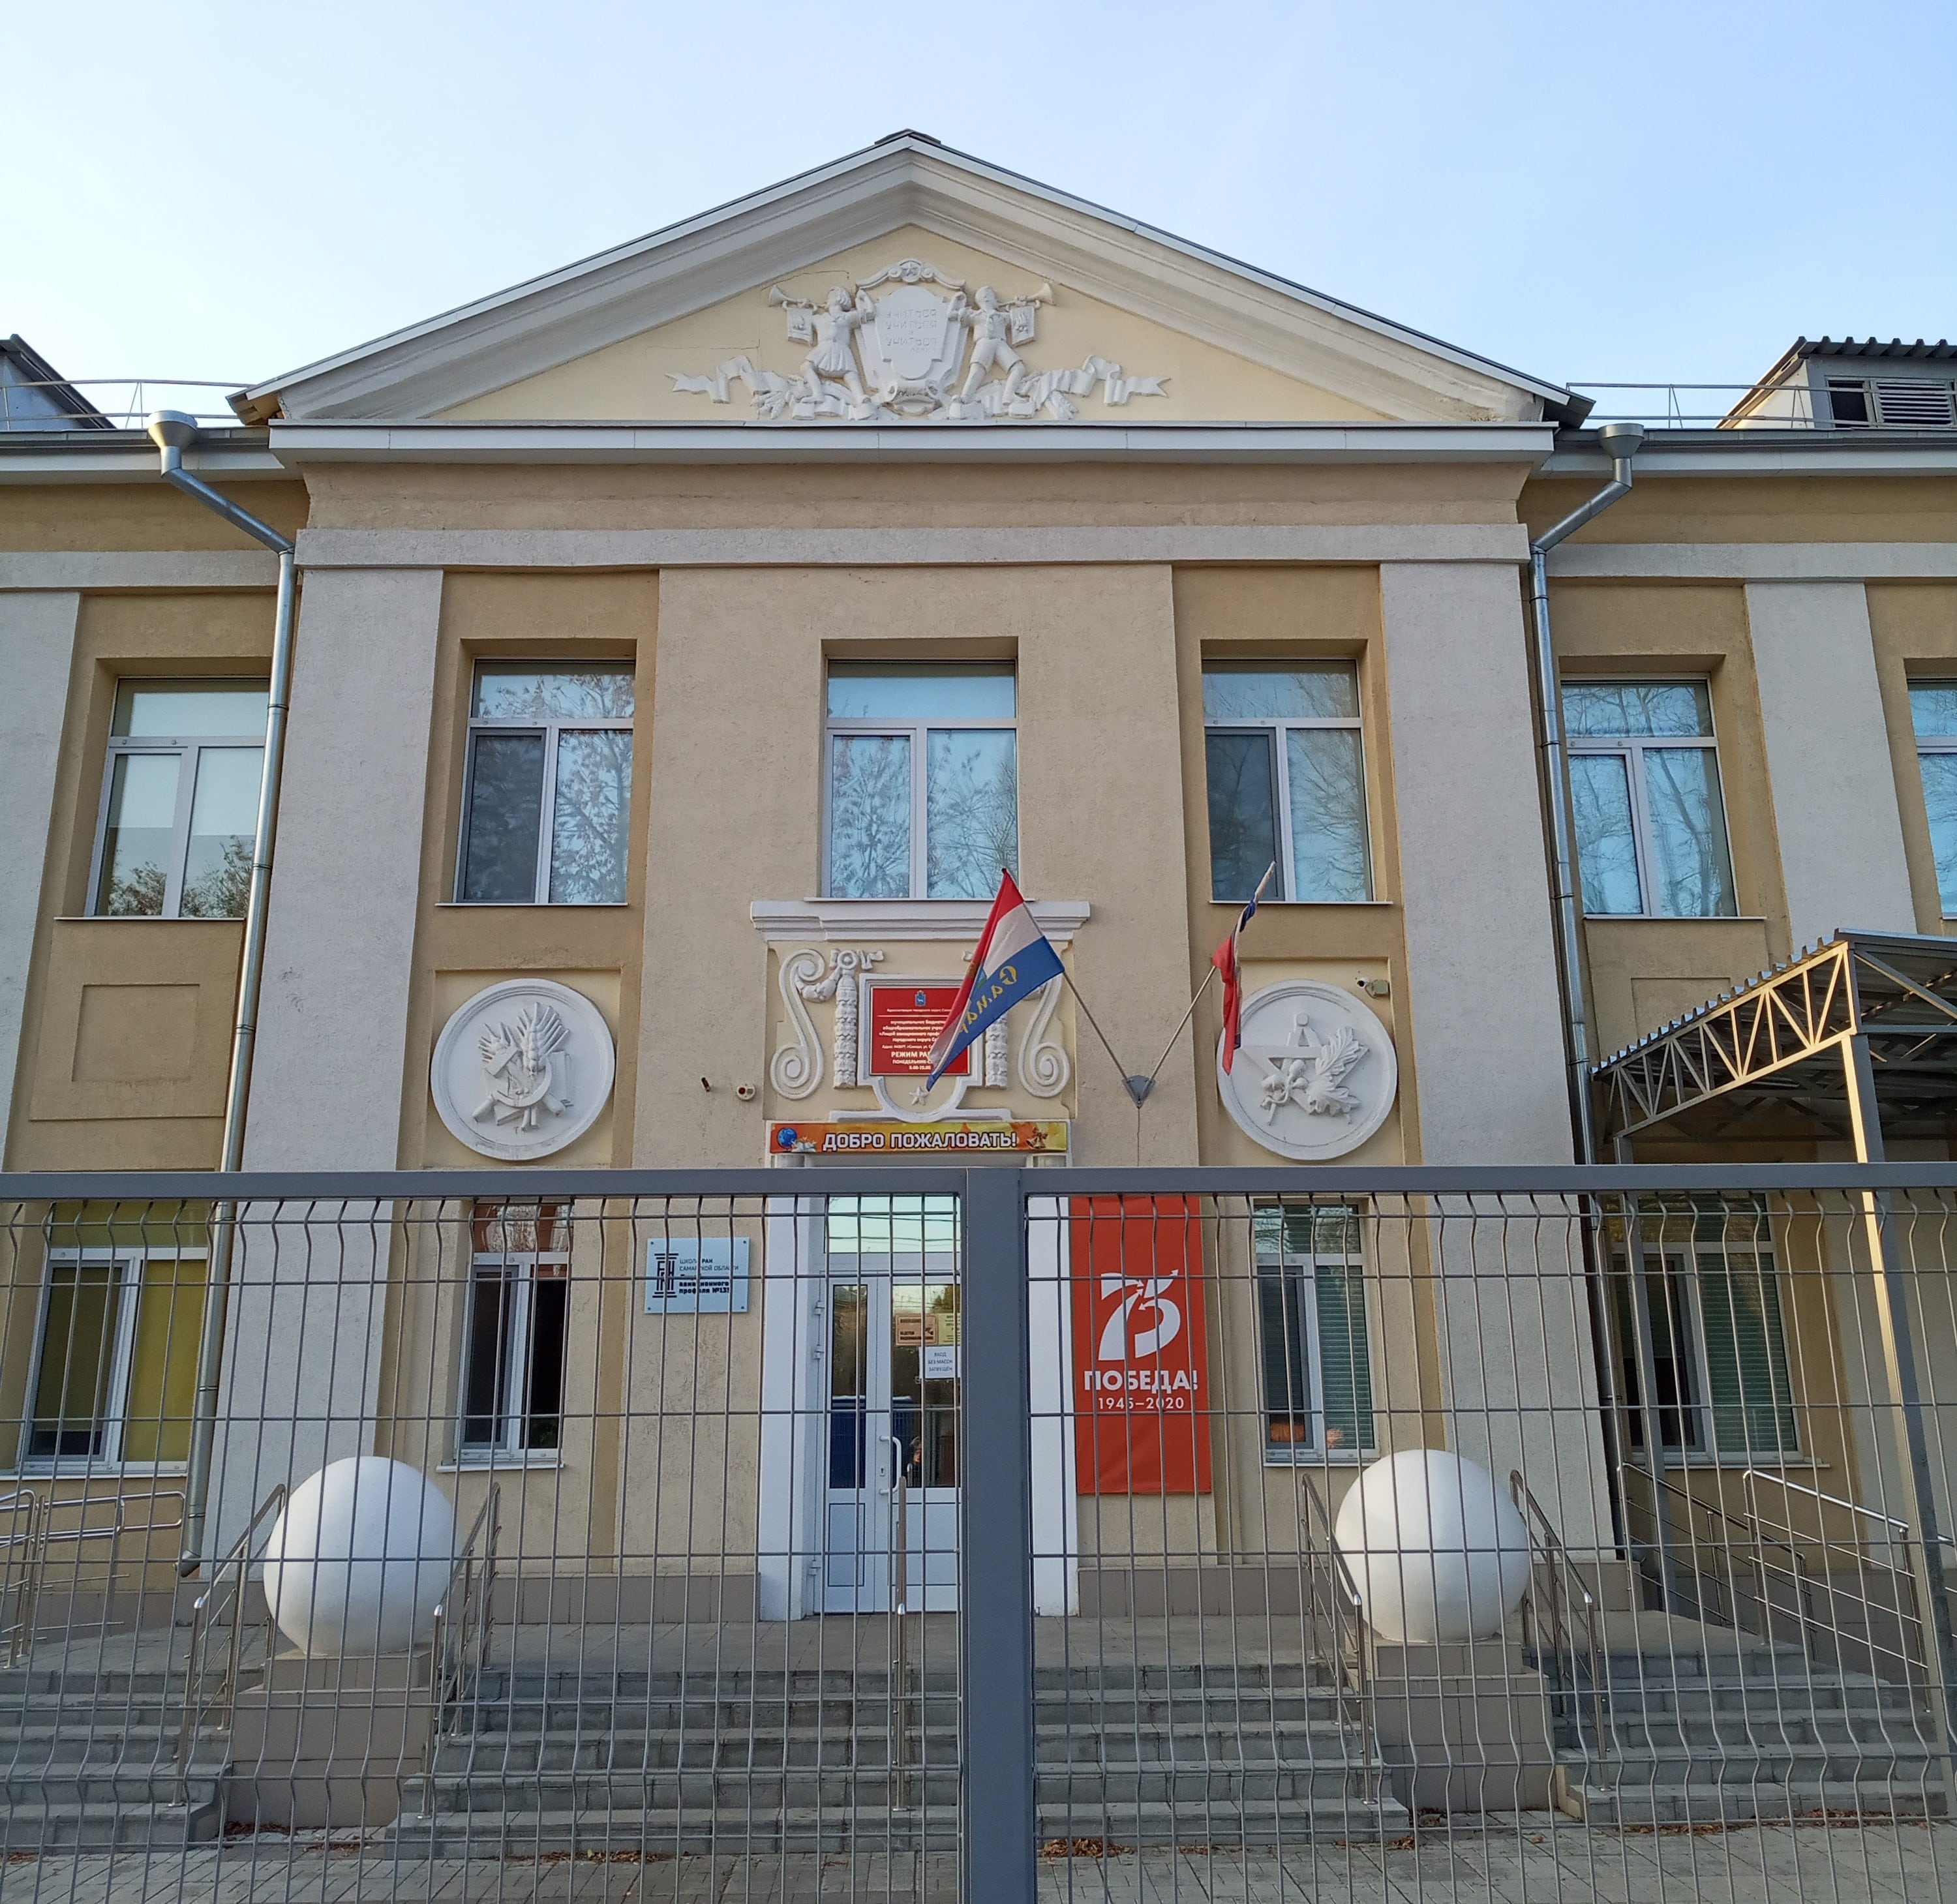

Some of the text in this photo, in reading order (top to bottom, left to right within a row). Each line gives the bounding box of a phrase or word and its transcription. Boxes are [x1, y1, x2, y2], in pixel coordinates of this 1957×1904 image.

[822, 1132, 1017, 1151] ДОБРО ПОЖАЛОВАТЬ!
[1098, 1269, 1181, 1361] 75
[1084, 1370, 1198, 1394] ПОБЕДА!
